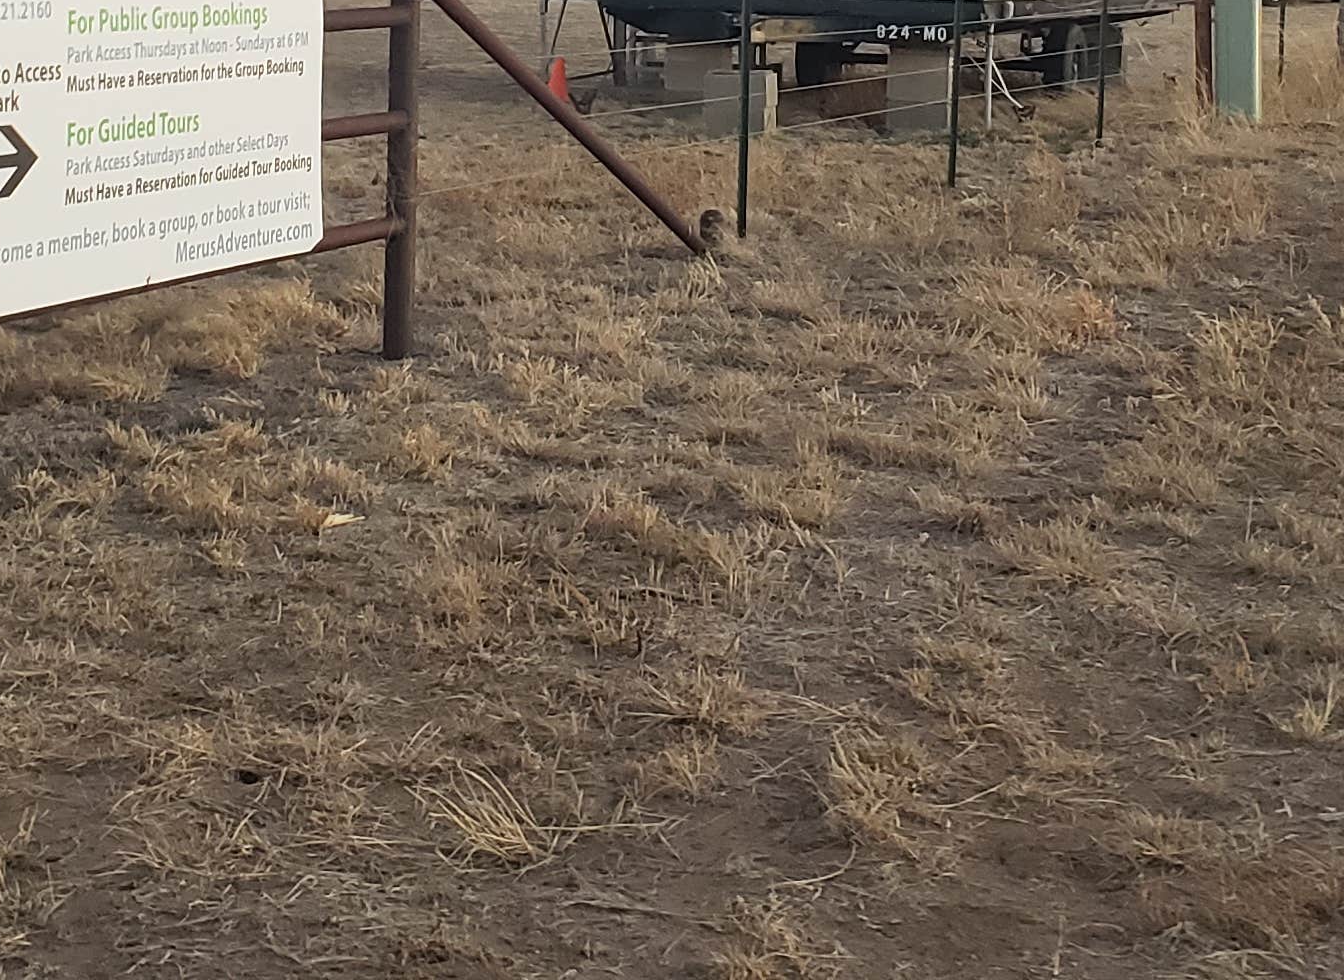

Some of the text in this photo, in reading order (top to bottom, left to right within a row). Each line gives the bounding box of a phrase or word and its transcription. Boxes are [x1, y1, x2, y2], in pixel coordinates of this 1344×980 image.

[68, 1, 268, 35] For Public Group Bookings
[67, 44, 93, 65] Park
[96, 45, 131, 62] Access
[134, 40, 186, 60] Thursdays
[189, 41, 199, 54] at
[201, 38, 228, 54] Noon
[236, 34, 274, 53] Sundays
[277, 34, 286, 48] at
[288, 32, 293, 48] 6
[296, 31, 309, 47] PM
[14, 62, 62, 83] Access
[67, 57, 304, 93] Must Have a Reservation for the Group Booking
[67, 111, 199, 147] For Guided Tours
[66, 132, 289, 176] Park Access Saturdays and other Select Days
[64, 153, 312, 206] Must Have a Reservation for Guided Tour Booking
[36, 241, 44, 257] a
[48, 227, 109, 255] member,
[112, 218, 146, 244] book
[148, 221, 156, 237] a
[159, 214, 198, 240] group,
[201, 210, 214, 226] or
[216, 200, 246, 224] book
[248, 203, 254, 218] a
[257, 197, 282, 216] tour
[175, 222, 313, 264] MerusAdventure.com
